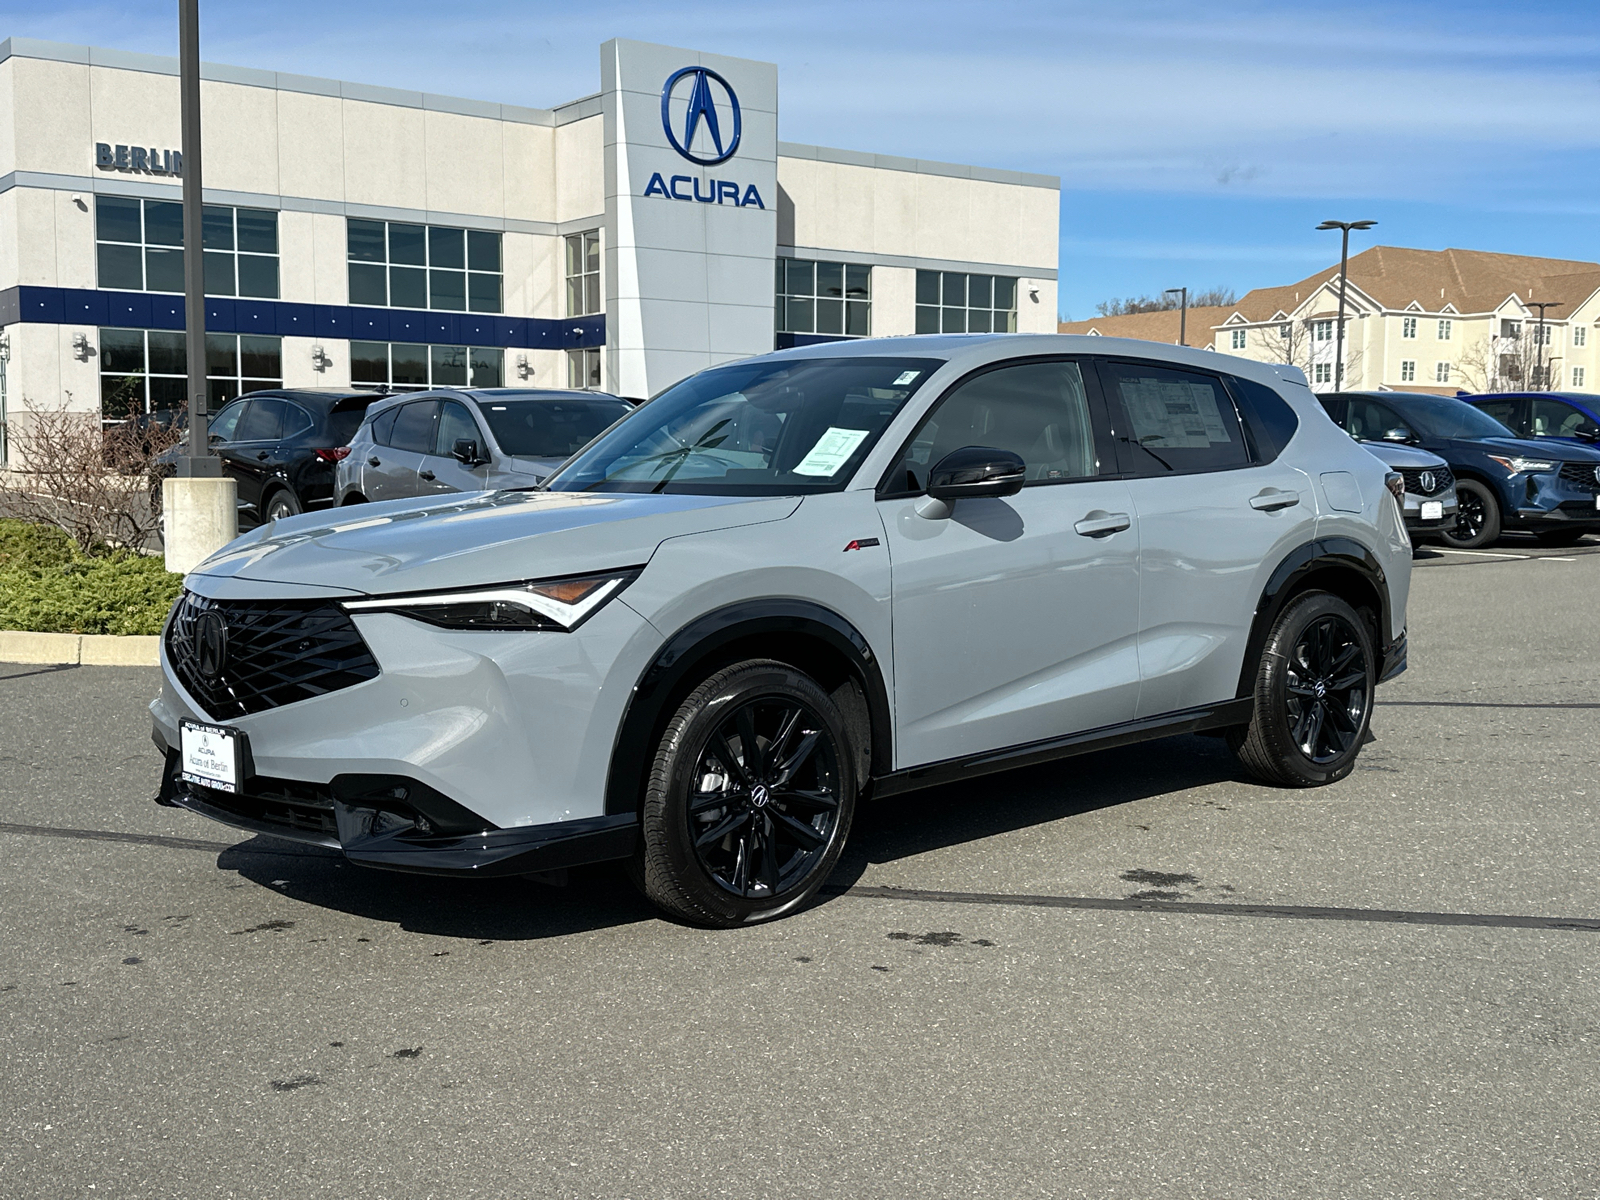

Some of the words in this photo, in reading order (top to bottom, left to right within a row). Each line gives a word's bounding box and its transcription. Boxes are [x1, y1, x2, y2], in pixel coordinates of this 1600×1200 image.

[644, 172, 765, 210] ACURA
[198, 747, 215, 756] ACURA
[190, 754, 202, 766] Acura
[204, 759, 210, 769] of
[211, 759, 228, 772] Berlin
